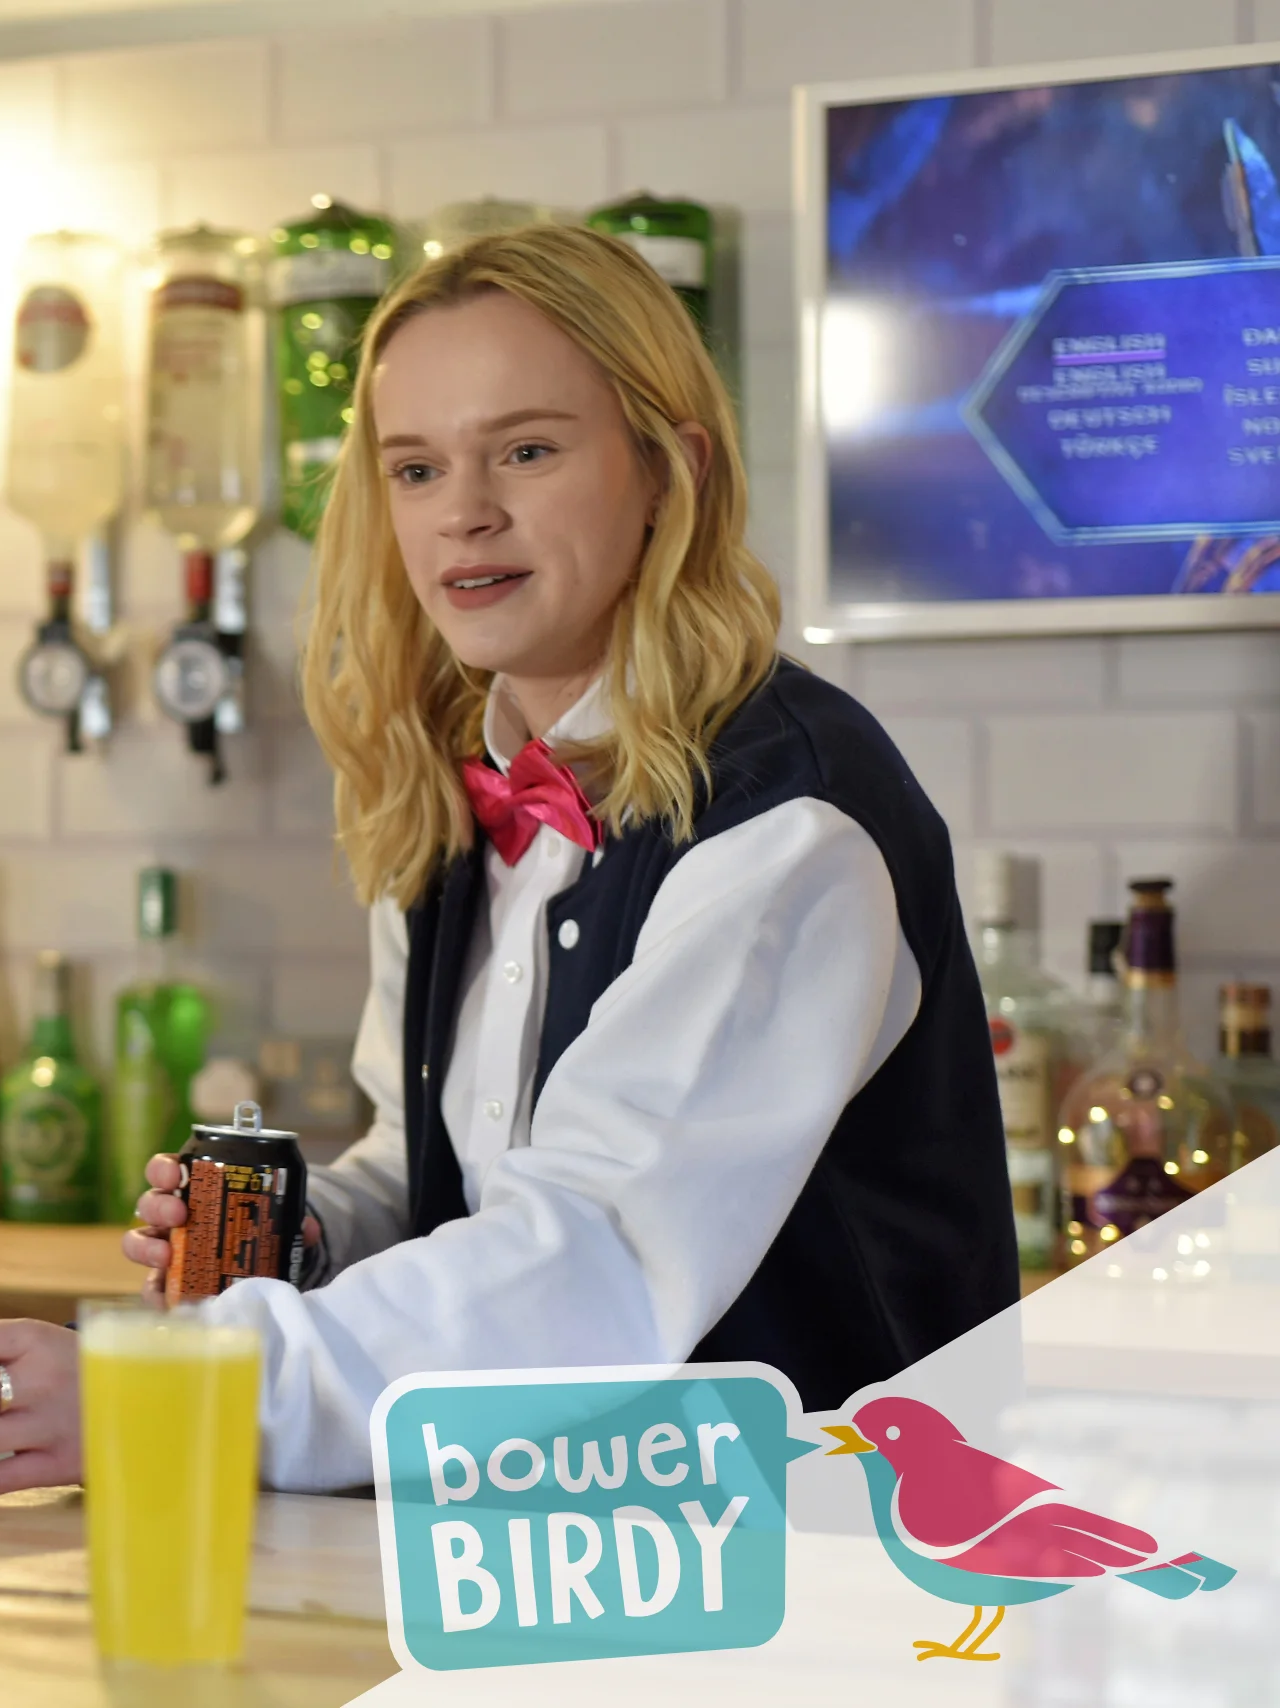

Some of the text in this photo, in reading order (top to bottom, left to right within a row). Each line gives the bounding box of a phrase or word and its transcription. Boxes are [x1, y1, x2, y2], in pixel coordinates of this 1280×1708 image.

[1051, 334, 1167, 353] ENGLISH
[1242, 327, 1280, 346] DA
[1227, 446, 1280, 466] SVE
